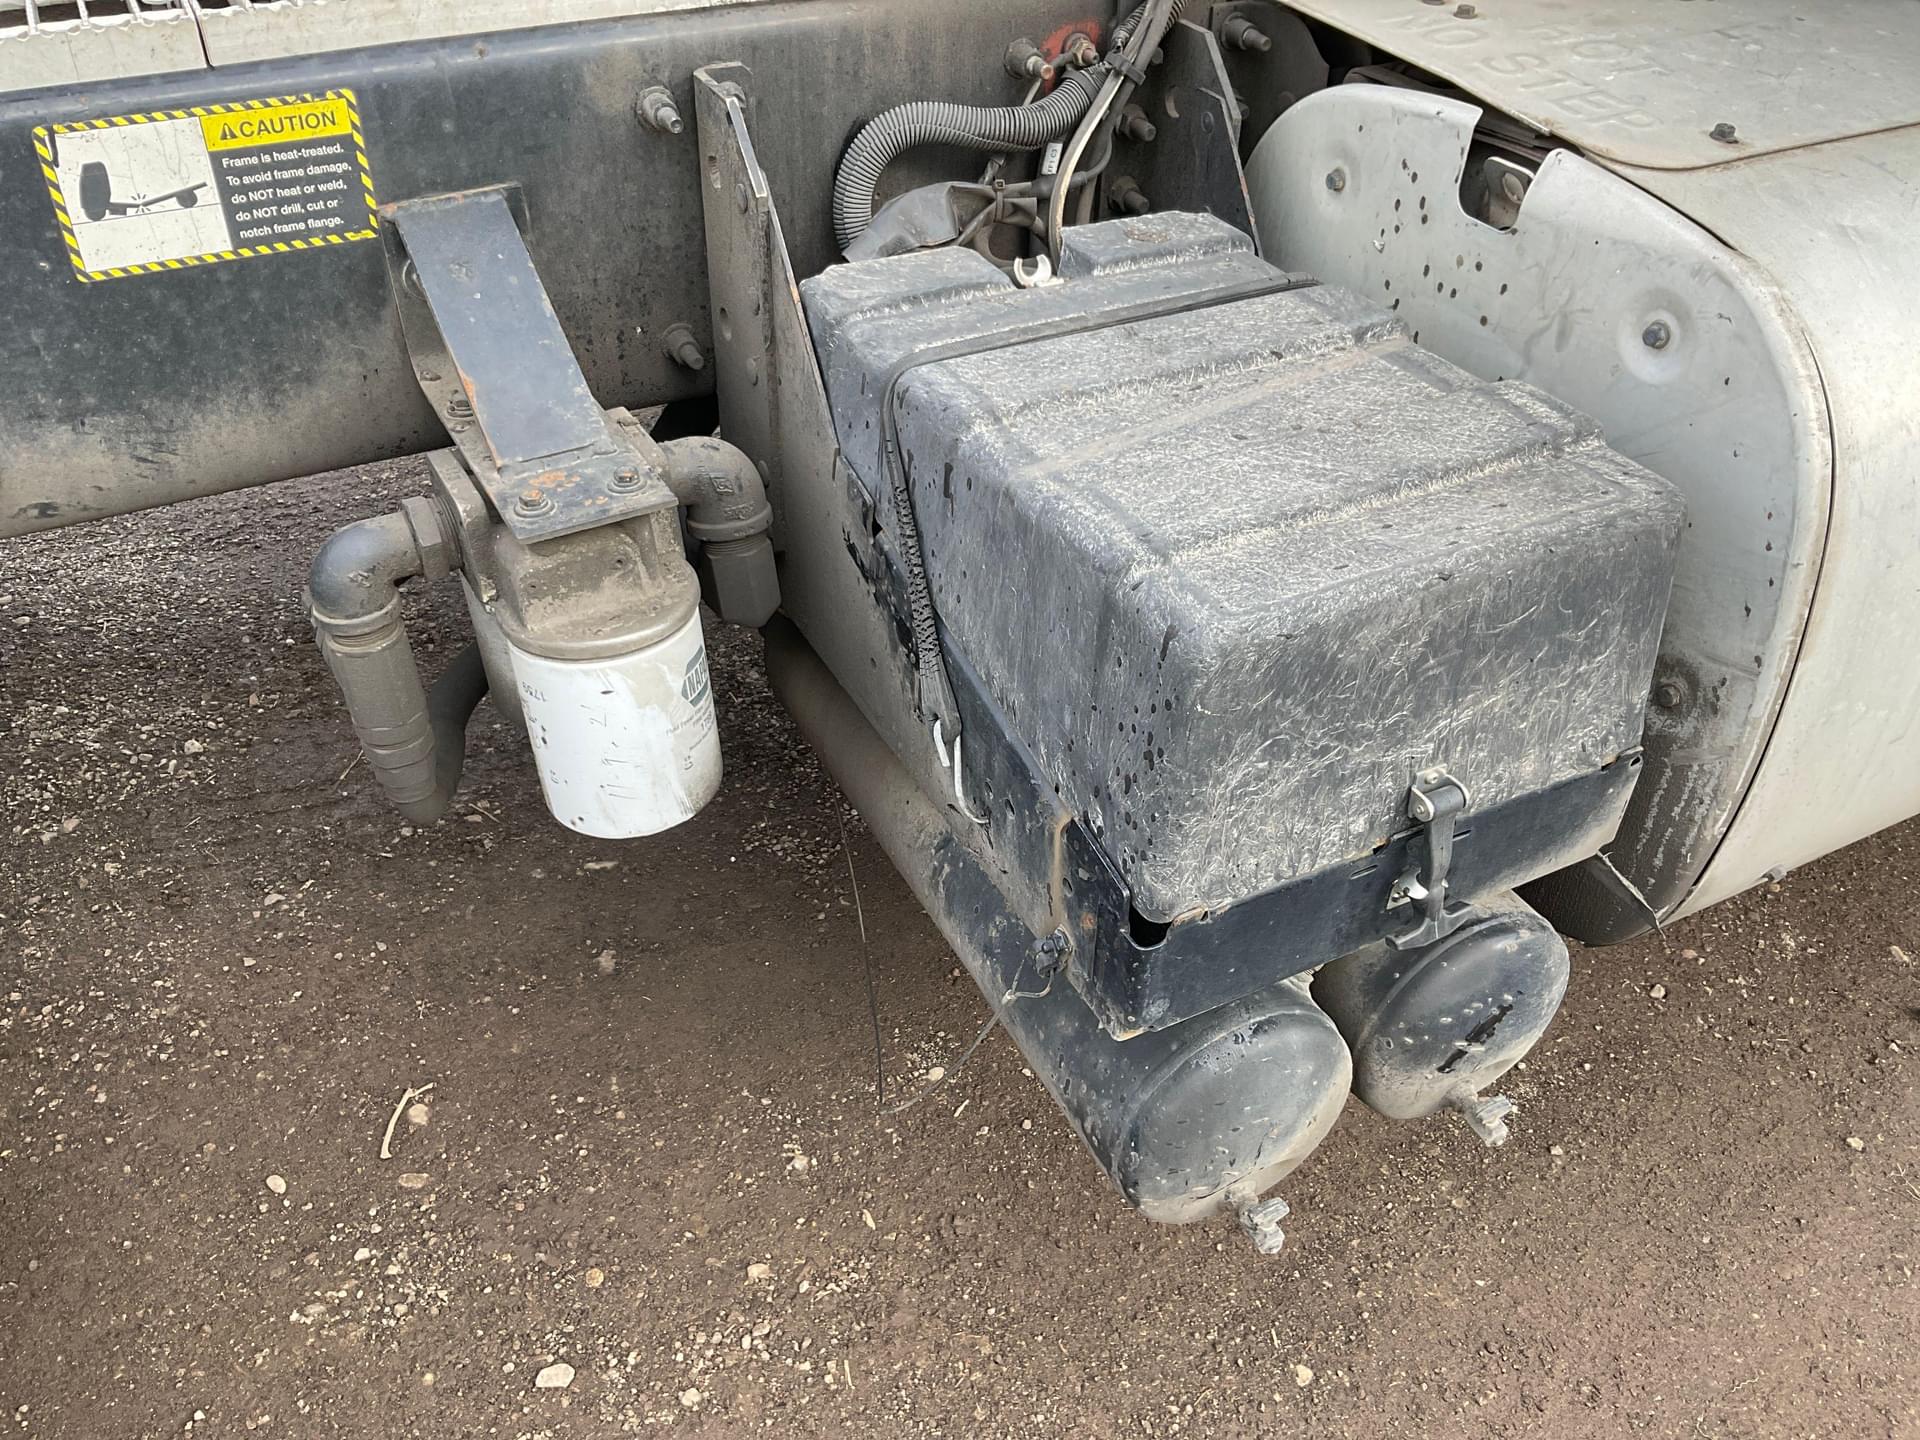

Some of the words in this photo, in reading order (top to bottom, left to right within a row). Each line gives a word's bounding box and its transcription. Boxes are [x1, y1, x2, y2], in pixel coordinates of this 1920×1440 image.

[1480, 53, 1664, 127] STEP
[239, 111, 336, 138] CAUTION
[222, 157, 259, 168] Frame
[261, 153, 271, 163] is
[273, 142, 344, 161] heat-treated.
[226, 175, 241, 186] To
[242, 171, 271, 184] avoid
[273, 168, 304, 180] frame
[306, 161, 351, 176] damage,
[231, 193, 247, 204] do
[248, 189, 275, 202] NOT
[276, 185, 302, 198] heat
[303, 183, 316, 194] or
[317, 178, 347, 191] weld,
[235, 211, 251, 222] do
[252, 206, 278, 219] NOT
[280, 203, 305, 216] drill,
[306, 199, 326, 211] cut
[327, 198, 339, 208] or
[239, 224, 272, 239] notch
[273, 222, 306, 235] frame
[306, 216, 344, 229] flange.
